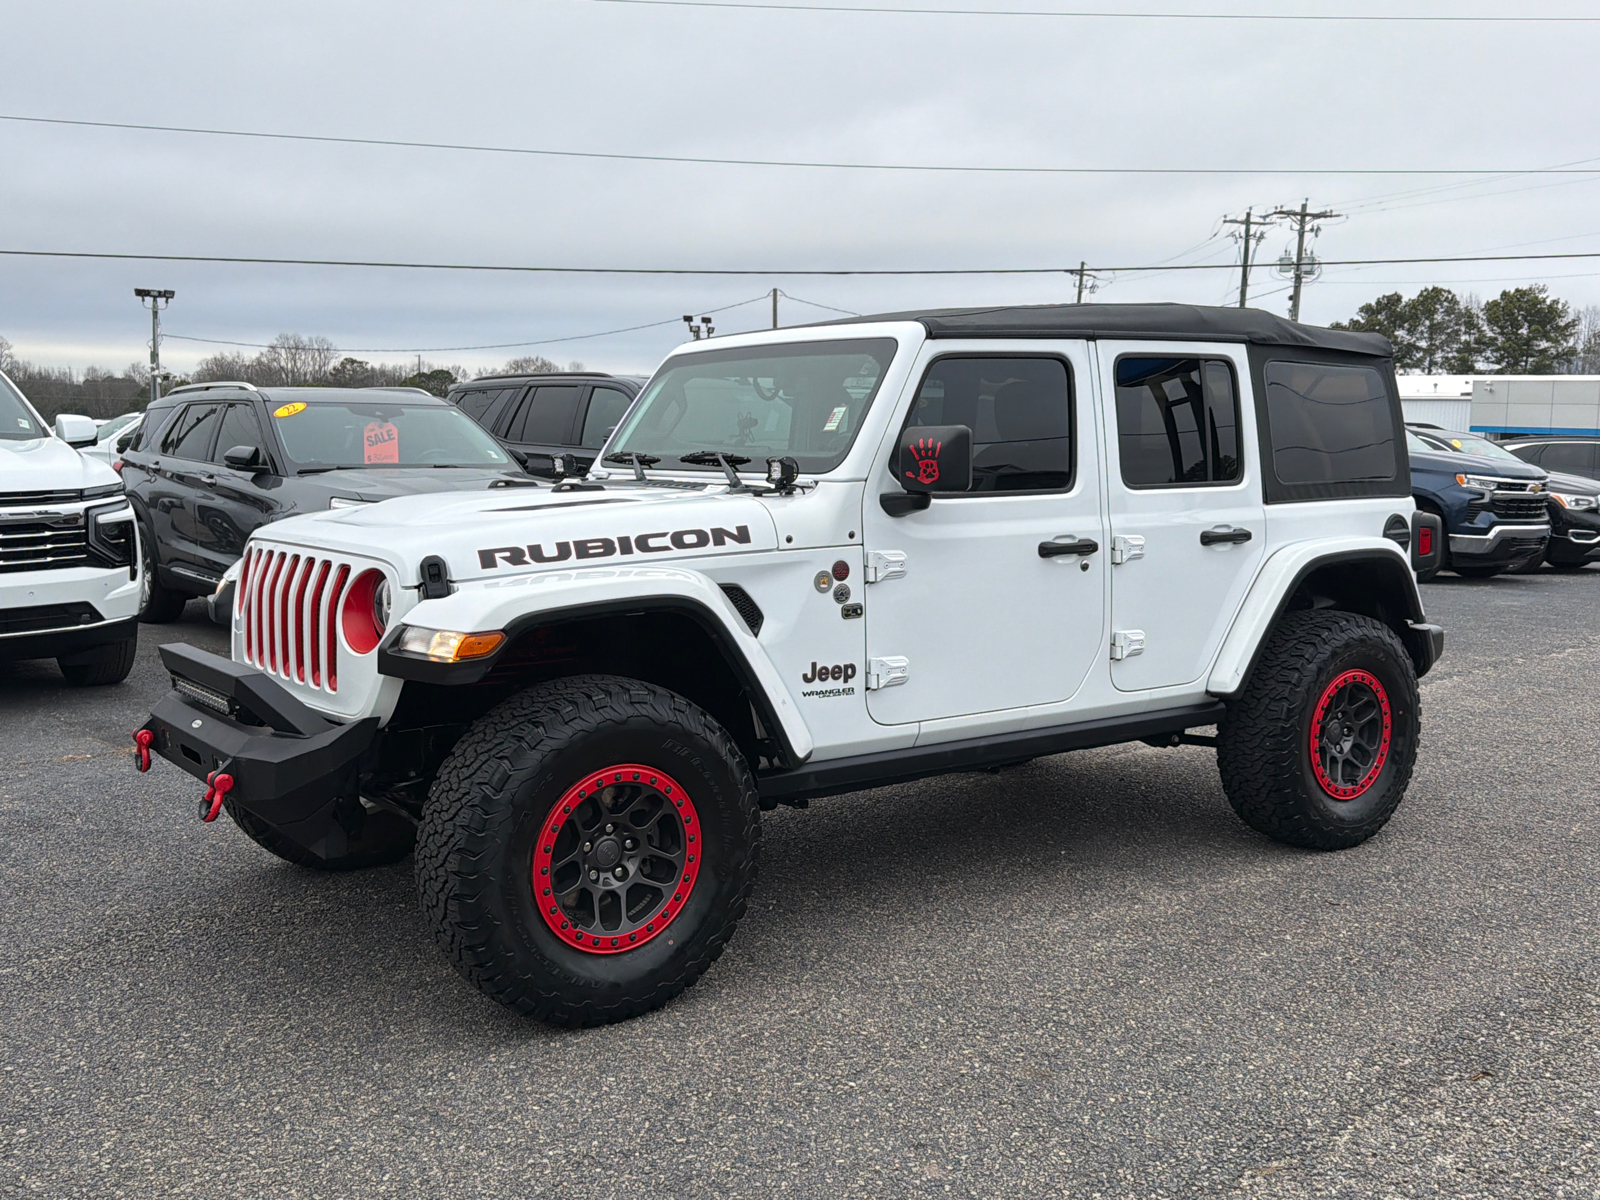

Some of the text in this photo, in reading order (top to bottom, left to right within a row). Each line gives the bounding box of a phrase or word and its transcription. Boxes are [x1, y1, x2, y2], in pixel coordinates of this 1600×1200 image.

[283, 404, 298, 415] 22
[366, 429, 395, 447] SALE
[477, 525, 752, 570] RUBICON
[802, 661, 857, 684] Jeep
[802, 687, 855, 697] WRANGLER
